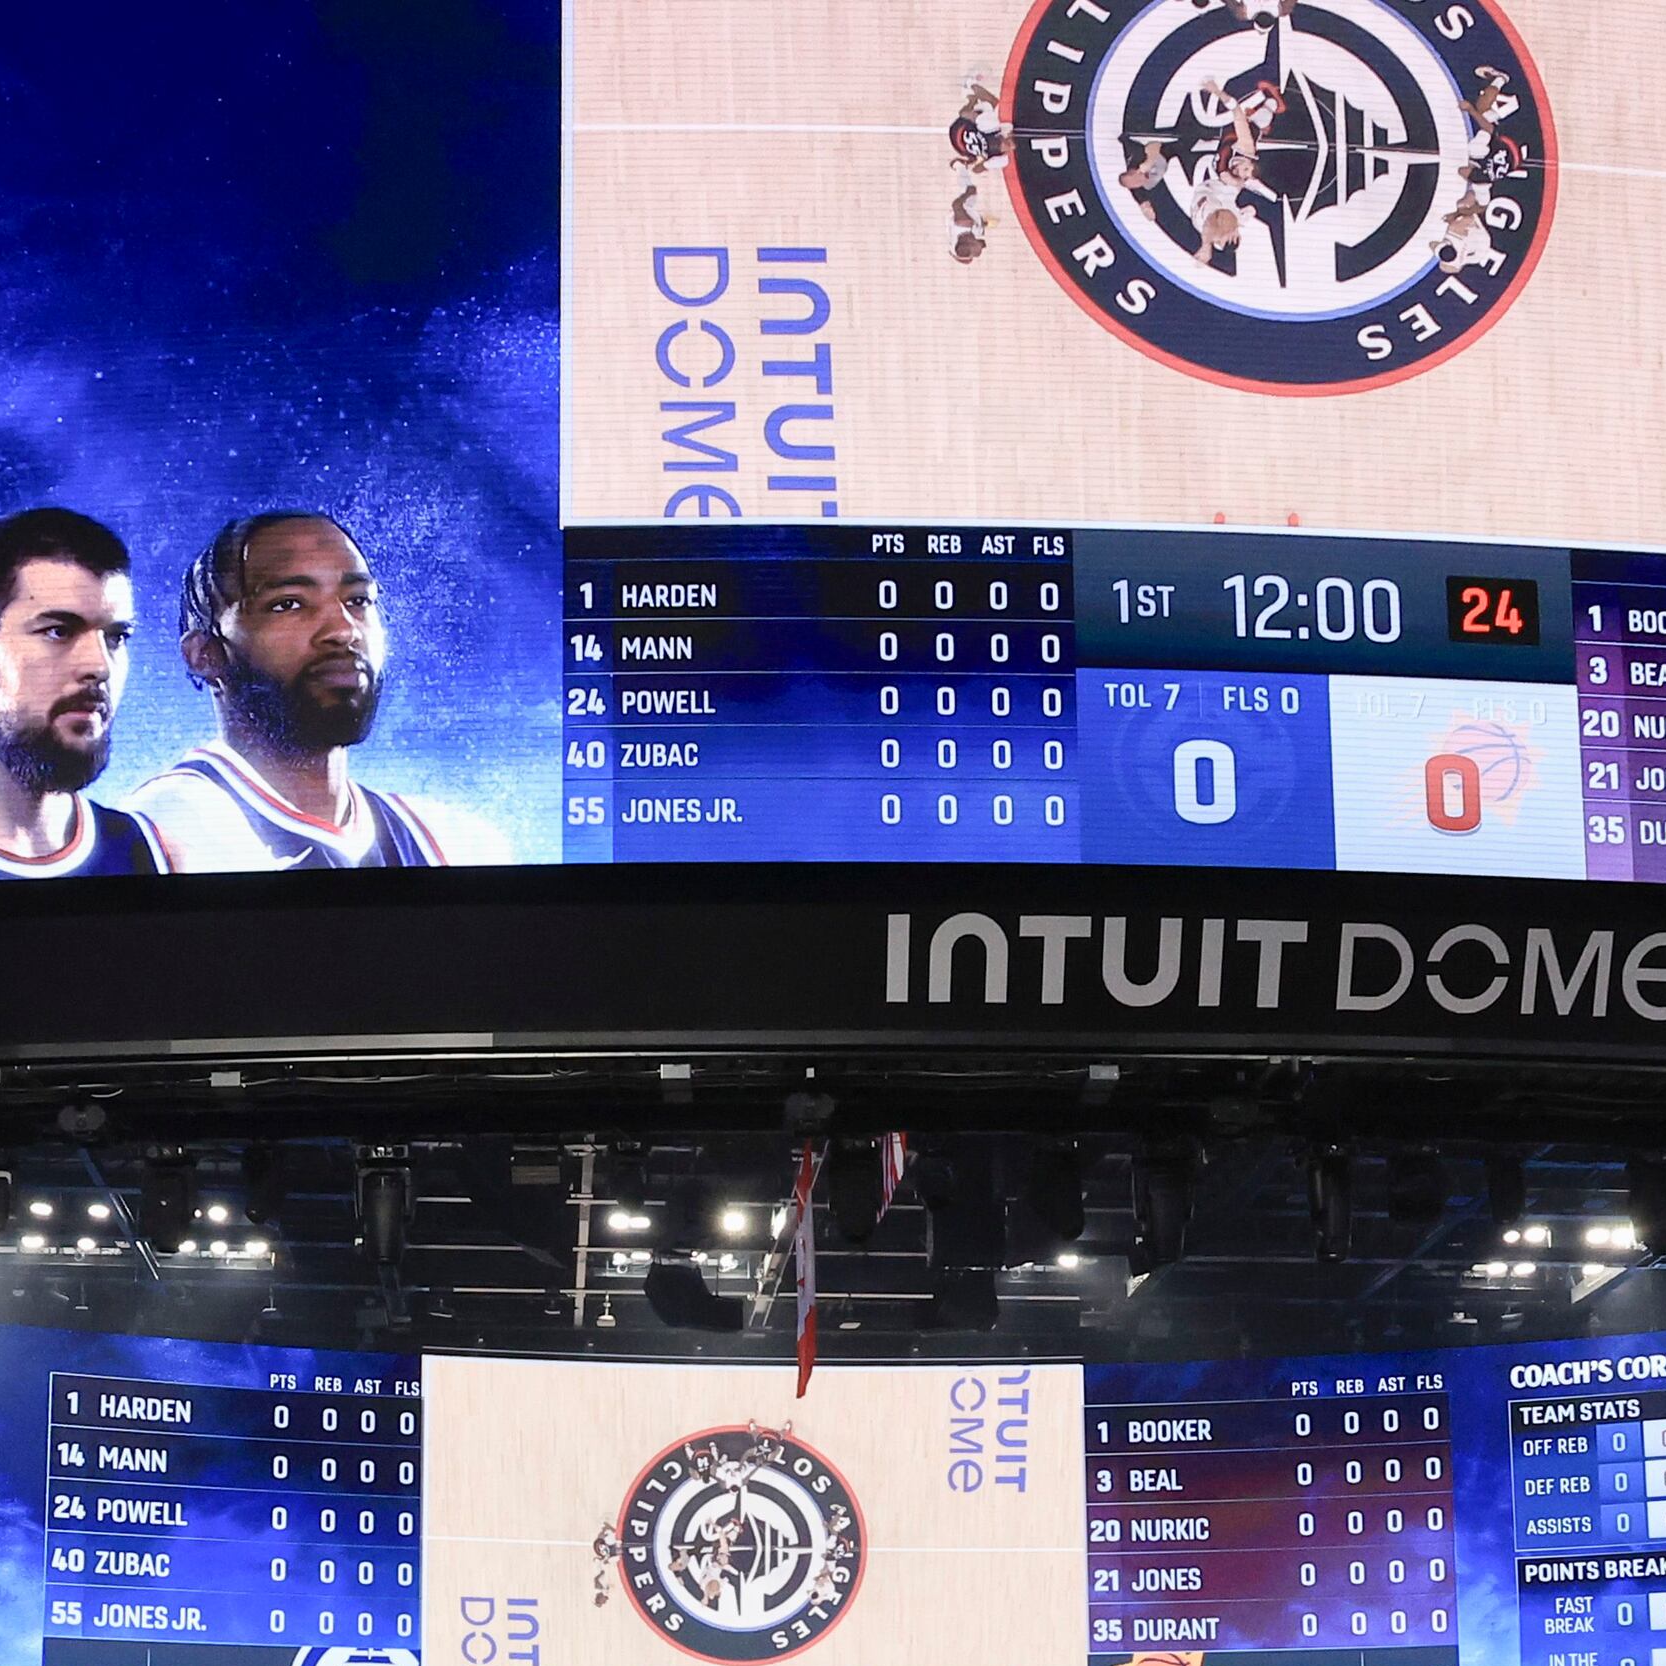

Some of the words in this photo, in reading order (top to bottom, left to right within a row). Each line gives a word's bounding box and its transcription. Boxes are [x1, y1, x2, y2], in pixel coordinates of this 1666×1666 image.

[873, 534, 904, 553] PTS
[928, 535, 961, 553] REB
[982, 535, 1015, 554] AST
[1034, 536, 1064, 555] FLS
[580, 583, 592, 608] 1
[623, 584, 716, 607] HARDEN
[1113, 580, 1174, 623] 1ST
[1224, 575, 1400, 642] 12:00
[1462, 588, 1522, 633] 24
[1589, 606, 1601, 631] 1
[571, 635, 602, 661] 14
[622, 637, 691, 660] MANN
[1590, 657, 1607, 683] 3
[568, 689, 605, 715] 24
[623, 691, 715, 714] POWELL
[1105, 684, 1151, 707] TOL
[1164, 684, 1179, 710] 7
[1224, 687, 1268, 711] FLS
[1281, 687, 1298, 713] 0
[1583, 710, 1619, 737] 20
[567, 742, 604, 768] 40
[621, 743, 698, 767] ZUBAC
[1174, 740, 1235, 823] 0
[1589, 762, 1618, 789] 21
[1425, 753, 1481, 835] 0
[568, 797, 604, 824] 55
[622, 799, 701, 822] JONES
[706, 799, 742, 822] JR.
[1589, 816, 1624, 844] 35
[1511, 1359, 1613, 1388] COACH'S
[68, 1392, 78, 1414] 1
[101, 1395, 191, 1423] HARDEN
[1098, 1422, 1107, 1442] 1
[1129, 1420, 1212, 1442] BOOKER
[58, 1443, 84, 1466] 14
[99, 1446, 166, 1472] MANN
[1097, 1470, 1111, 1492] 3
[1130, 1469, 1183, 1491] BEAL
[54, 1495, 86, 1519] 24
[98, 1499, 188, 1526] POWELL
[1091, 1520, 1120, 1541] 20
[1132, 1518, 1209, 1541] NURKIC
[52, 1548, 84, 1572] 40
[95, 1551, 169, 1577] ZUBAC
[1526, 1561, 1599, 1582] POINTS
[1095, 1570, 1118, 1591] 21
[1132, 1568, 1201, 1591] JONES
[1094, 1620, 1122, 1641] 35
[1134, 1618, 1219, 1641] DURANT
